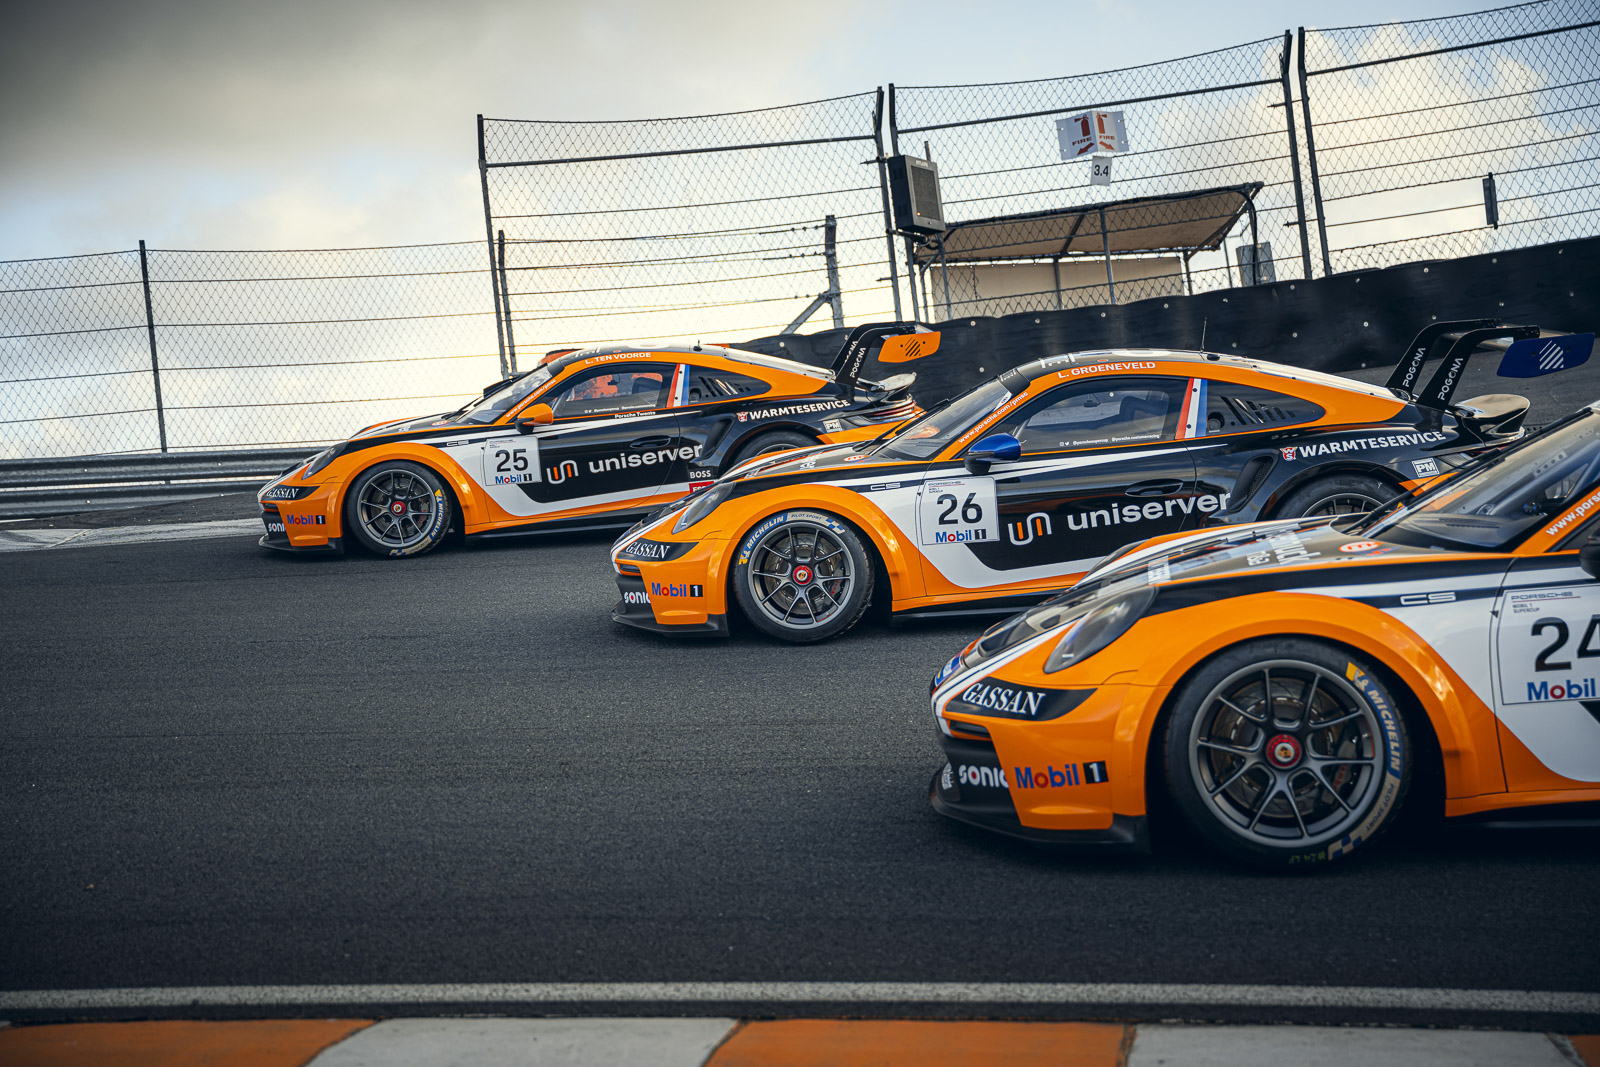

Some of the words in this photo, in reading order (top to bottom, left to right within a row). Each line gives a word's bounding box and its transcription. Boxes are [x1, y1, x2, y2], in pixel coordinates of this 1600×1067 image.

[1072, 137, 1092, 146] FIRE
[1094, 164, 1109, 177] 3.4
[613, 352, 652, 360] VOORDE
[850, 347, 866, 378] POGONA
[1402, 347, 1426, 388] POGONA
[1057, 371, 1069, 379] L.
[1071, 361, 1156, 377] GROENEVELD
[1437, 358, 1464, 401] POGONA
[749, 399, 851, 420] WARMTESERVICE
[1299, 431, 1446, 458] WARMTESERVICE
[495, 448, 529, 472] 25
[588, 444, 703, 474] uniserver
[1415, 462, 1436, 473] PM
[495, 474, 522, 484] Mobil
[689, 470, 712, 479] BOSS
[266, 488, 300, 498] GASSAN
[286, 514, 314, 525] Mobil
[431, 502, 443, 537] MICHELIN
[936, 492, 983, 526] 26
[1066, 492, 1231, 531] uniserver
[746, 515, 784, 549] MICHELIN
[935, 530, 972, 543] Mobil
[625, 541, 670, 559] GASSAN
[651, 582, 687, 597] Mobil
[1511, 591, 1573, 600] PORSCHE
[1531, 614, 1600, 673] 24
[962, 682, 1046, 716] GASSAN
[1527, 678, 1596, 701] Mobil
[1367, 689, 1400, 771] MICHELIN
[1014, 763, 1080, 789] Mobil
[1383, 783, 1395, 807] PILOT
[1365, 808, 1385, 832] SPORT
